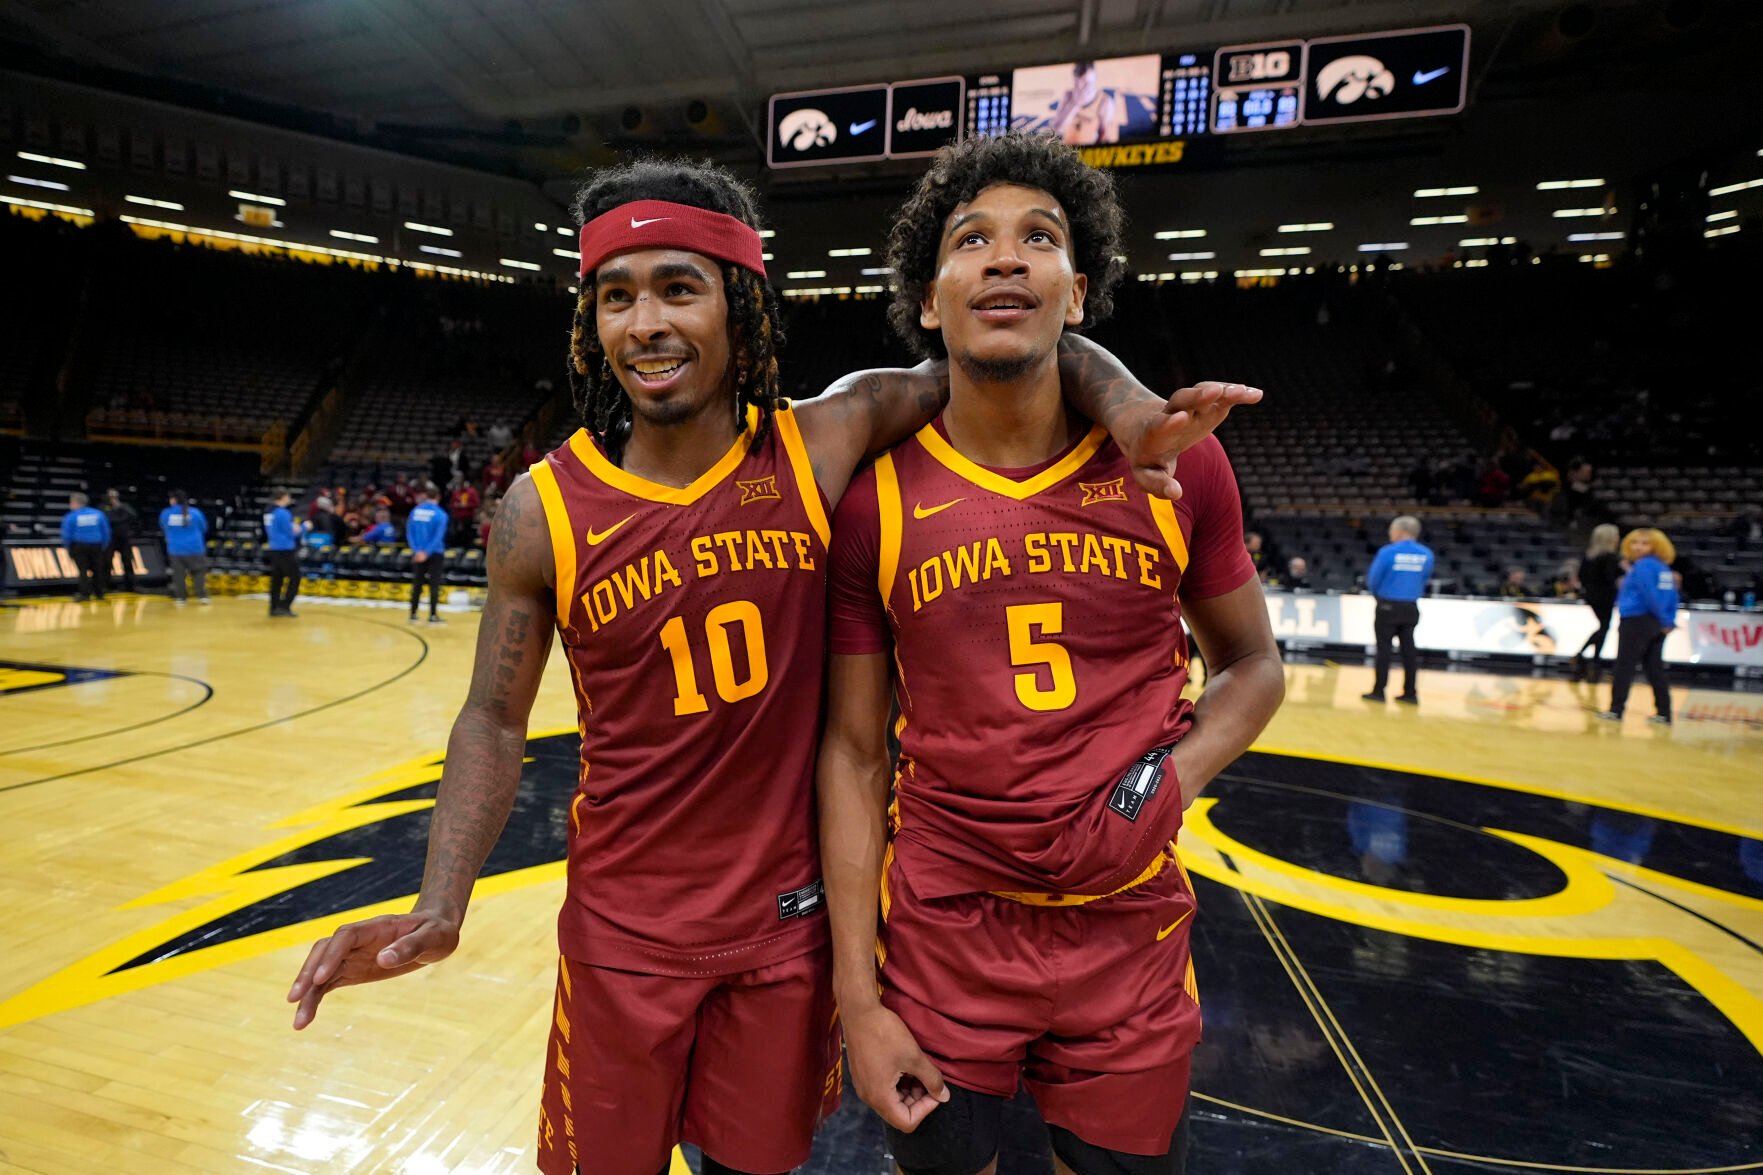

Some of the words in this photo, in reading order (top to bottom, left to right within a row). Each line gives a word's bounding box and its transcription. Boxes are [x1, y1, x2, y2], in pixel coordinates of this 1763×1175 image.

[897, 107, 953, 132] Iowa
[1079, 477, 1128, 507] XII
[580, 549, 682, 633] IOWA
[690, 530, 816, 578] STATE
[908, 537, 1011, 613] IOWA
[1024, 532, 1162, 590] STATE
[659, 600, 769, 716] 10
[1006, 601, 1077, 711] 5
[1143, 752, 1158, 762] 44
